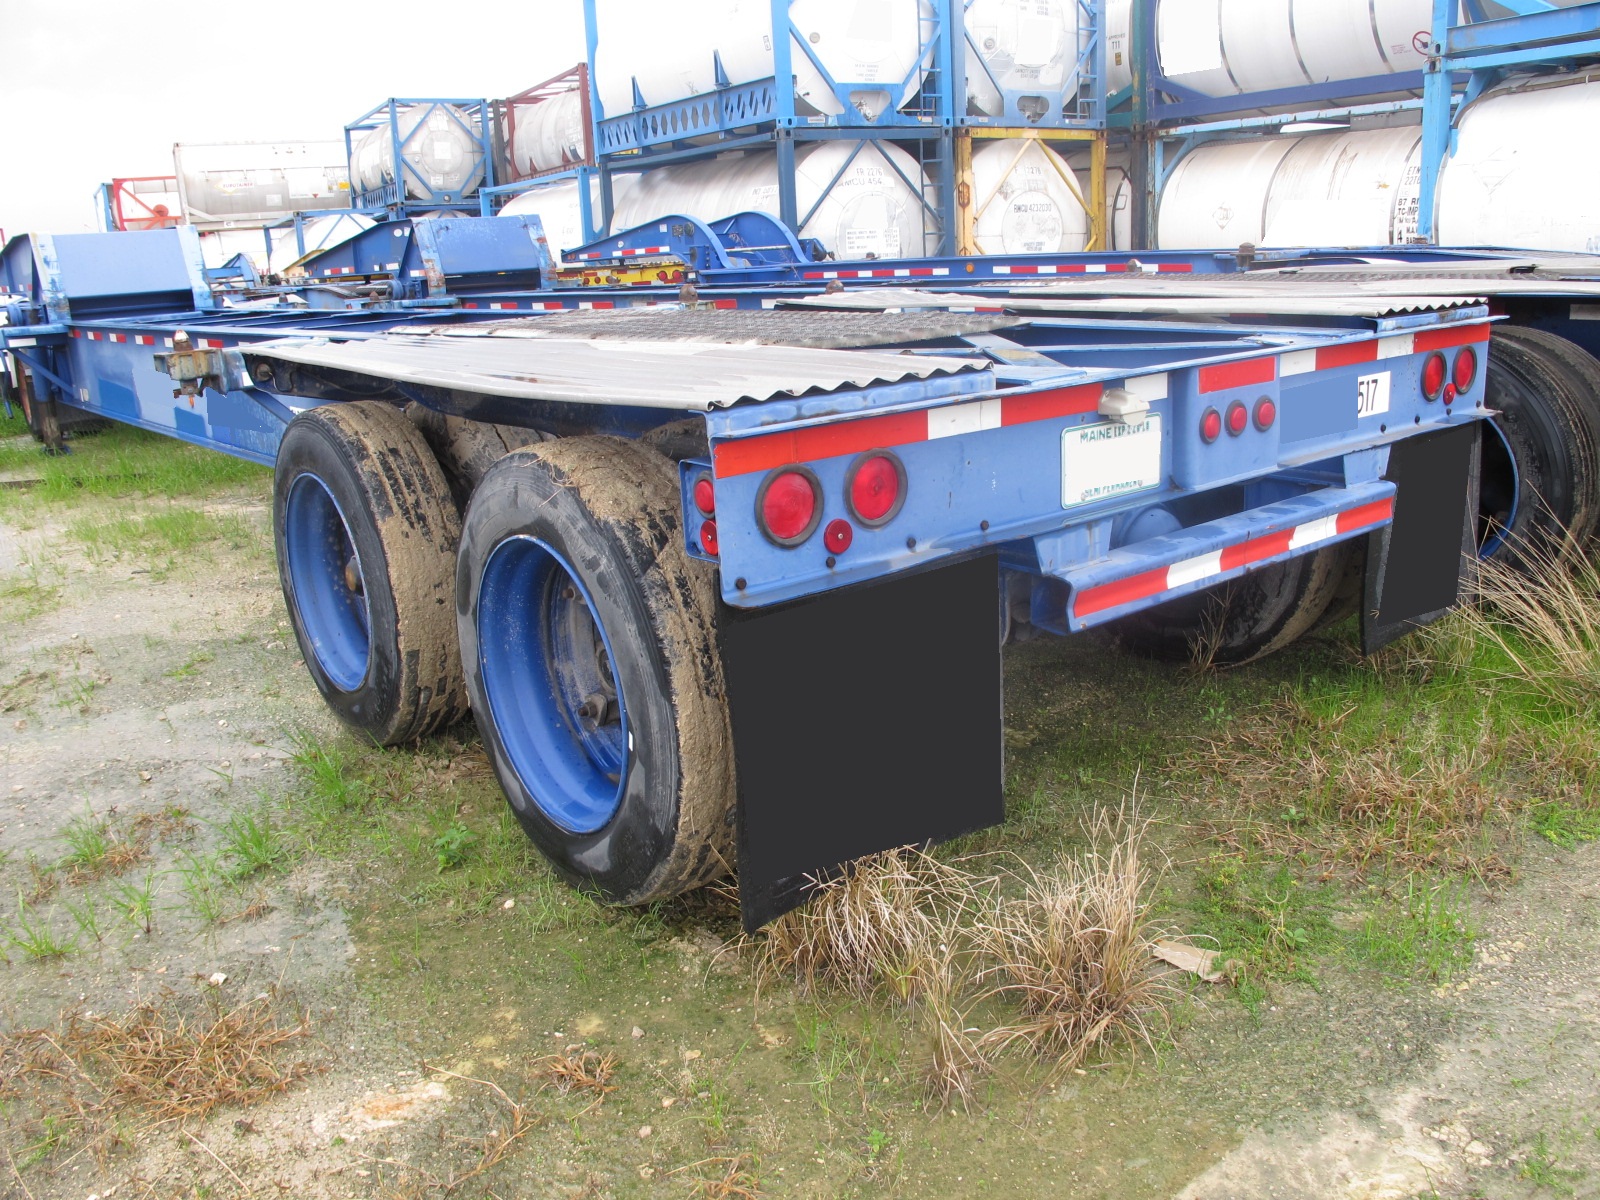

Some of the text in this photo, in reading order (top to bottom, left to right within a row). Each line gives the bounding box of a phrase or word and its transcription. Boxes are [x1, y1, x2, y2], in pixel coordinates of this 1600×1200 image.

[1111, 41, 1121, 50] T11
[1357, 378, 1379, 414] 517
[1079, 427, 1112, 444] MAINE
[1102, 480, 1142, 495] PERMANEN
